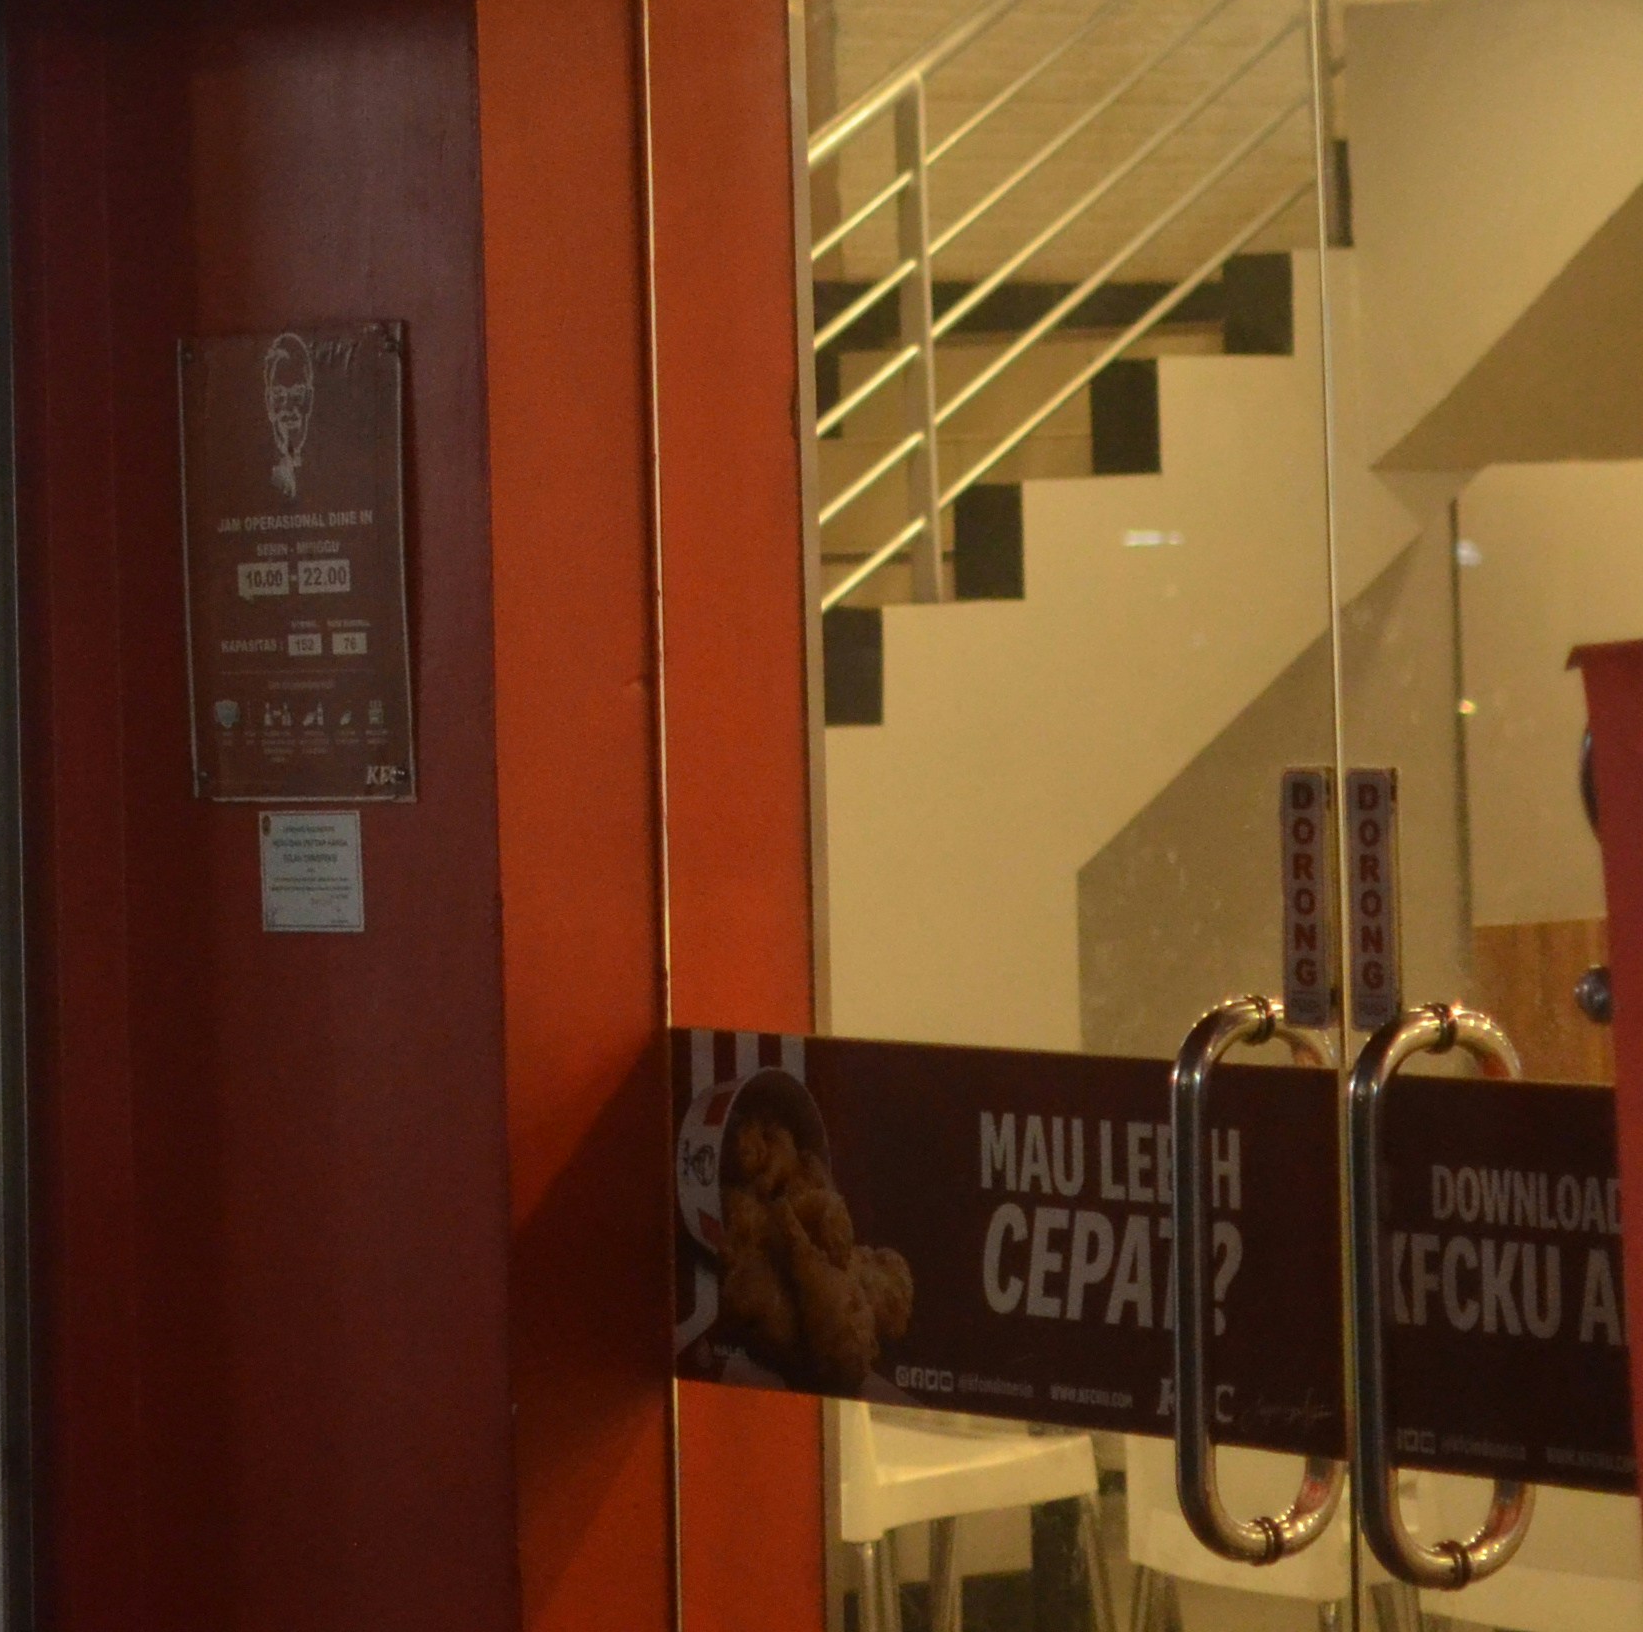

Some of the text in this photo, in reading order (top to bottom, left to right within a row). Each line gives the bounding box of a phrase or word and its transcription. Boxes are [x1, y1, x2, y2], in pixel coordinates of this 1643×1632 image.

[244, 513, 324, 531] OPERASIONAL
[328, 511, 357, 526] DINE
[360, 510, 373, 524] IN
[246, 566, 347, 589] 10.00 22.00
[1291, 780, 1317, 987] DORONG
[1356, 782, 1385, 991] DORONG
[979, 1111, 1085, 1197] MAU
